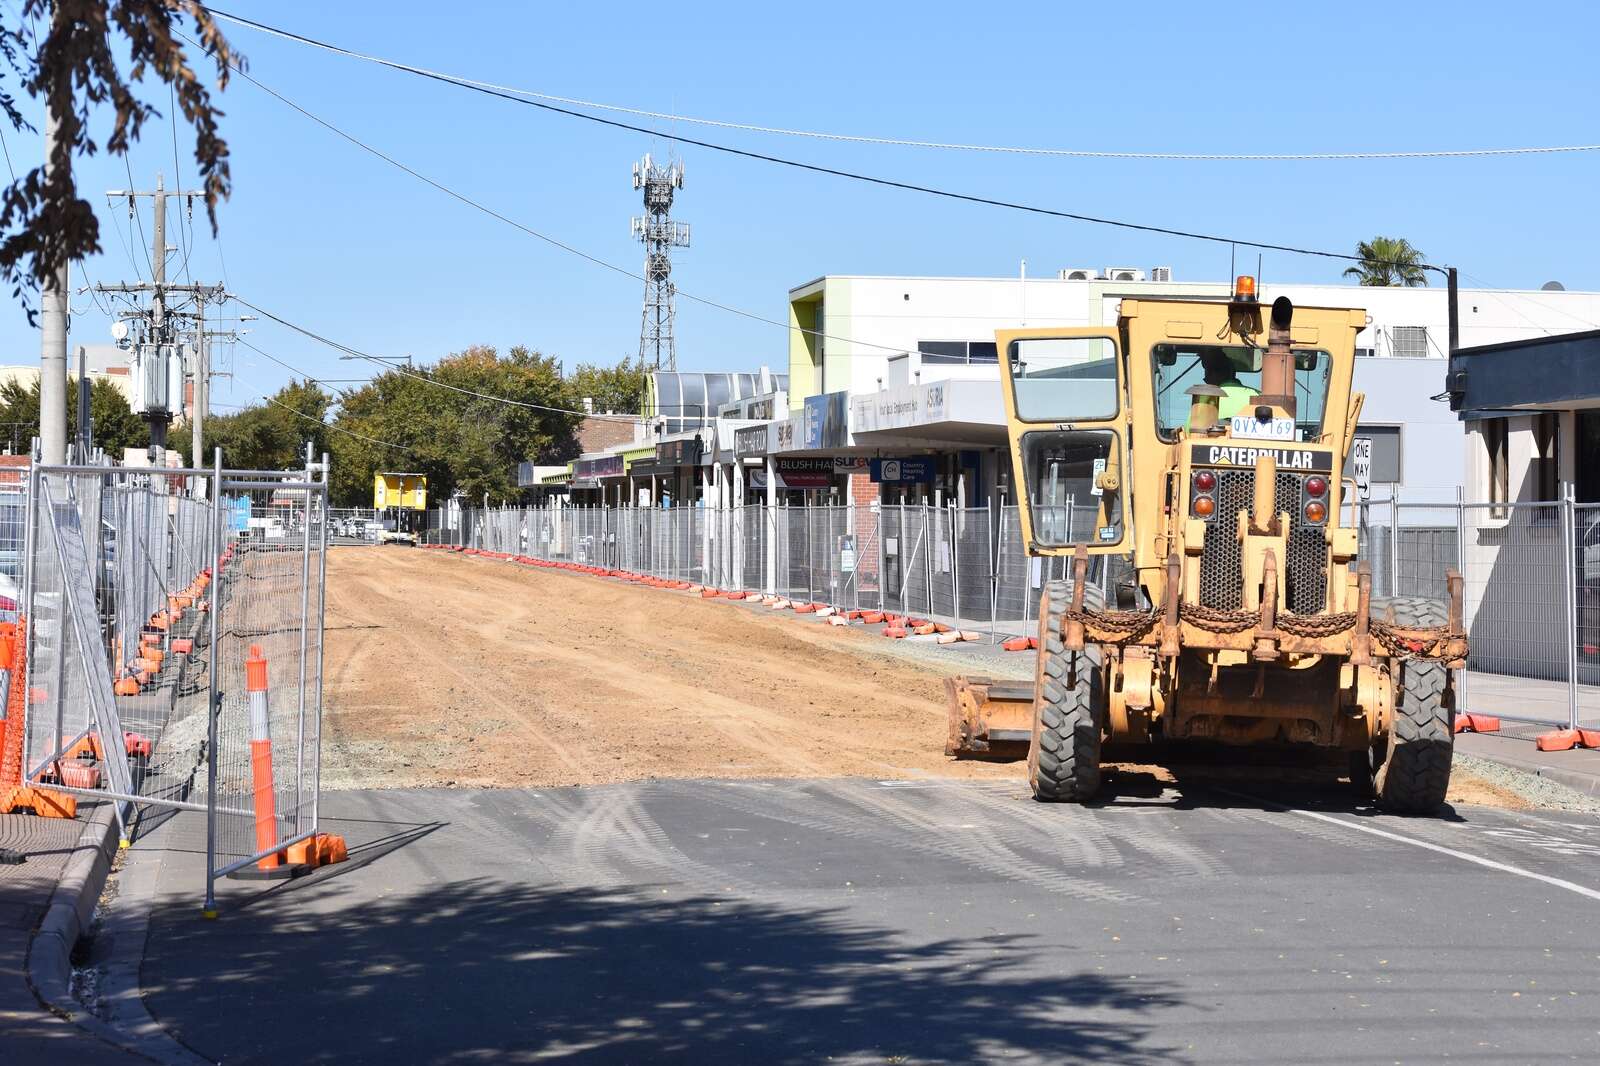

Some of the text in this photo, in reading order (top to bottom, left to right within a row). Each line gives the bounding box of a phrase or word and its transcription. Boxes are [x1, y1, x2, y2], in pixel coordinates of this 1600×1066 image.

[1270, 420, 1292, 435] 169
[1355, 444, 1369, 458] ONE
[781, 460, 834, 471] BLUSH HAI
[1354, 463, 1370, 477] WAY
